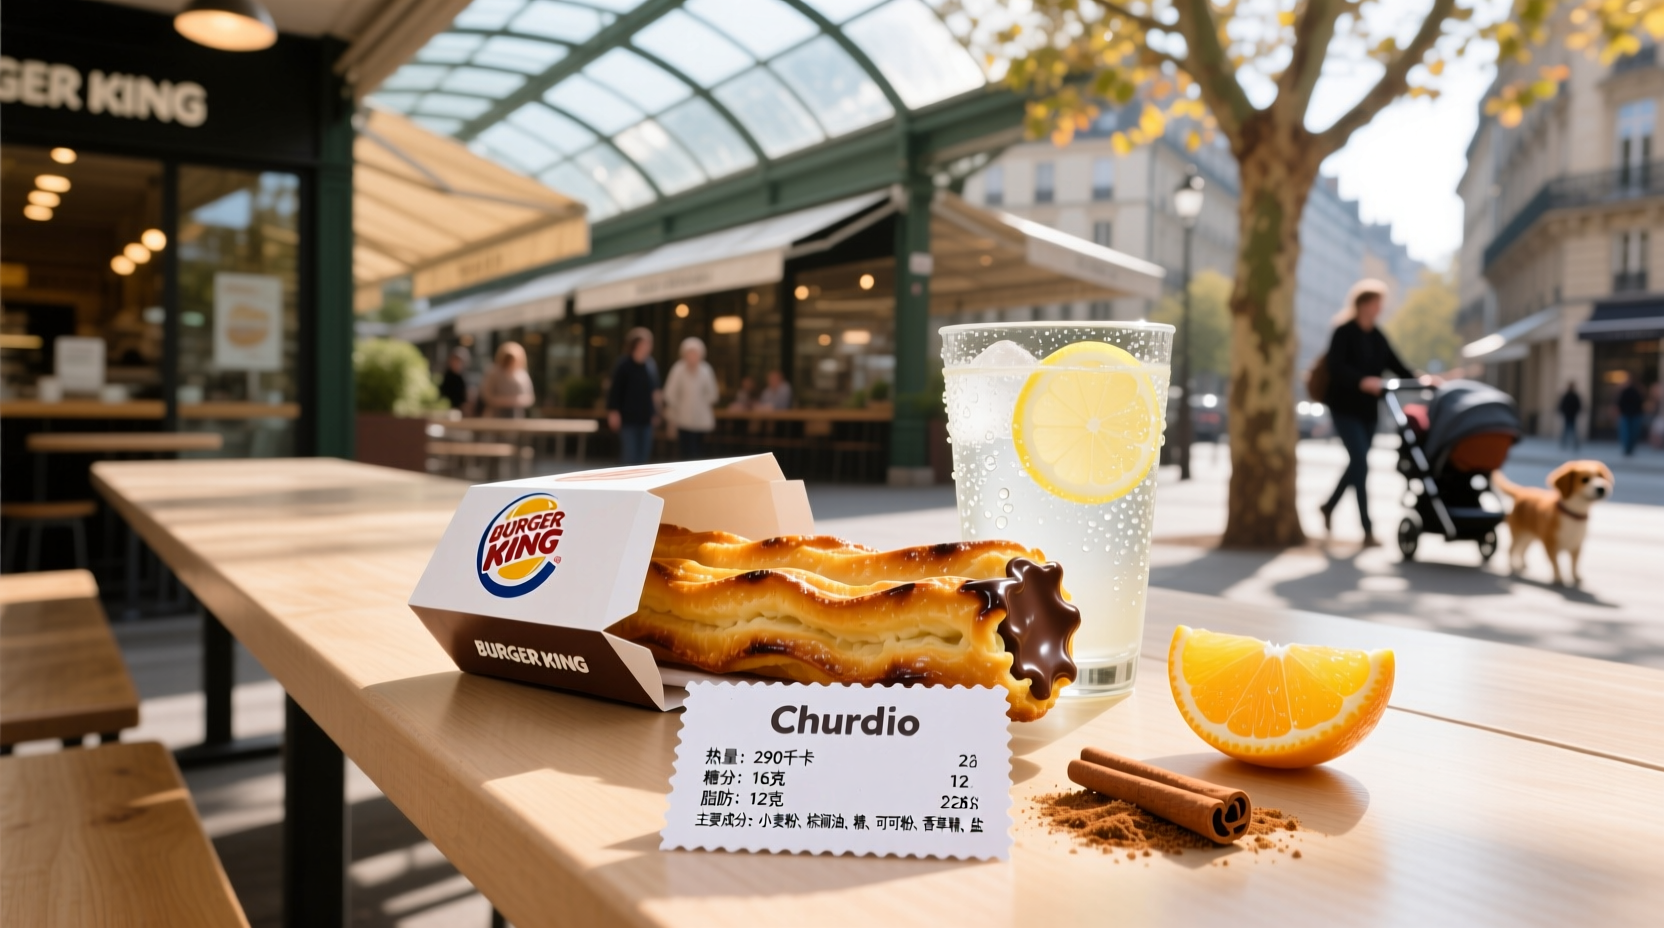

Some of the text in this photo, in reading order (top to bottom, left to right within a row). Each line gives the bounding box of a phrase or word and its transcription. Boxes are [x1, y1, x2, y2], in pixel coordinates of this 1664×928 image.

[88, 70, 208, 127] KING
[489, 511, 565, 543] BURGER
[483, 528, 564, 571] KING
[474, 639, 590, 674] BURGER KING
[770, 704, 920, 737] Churdio
